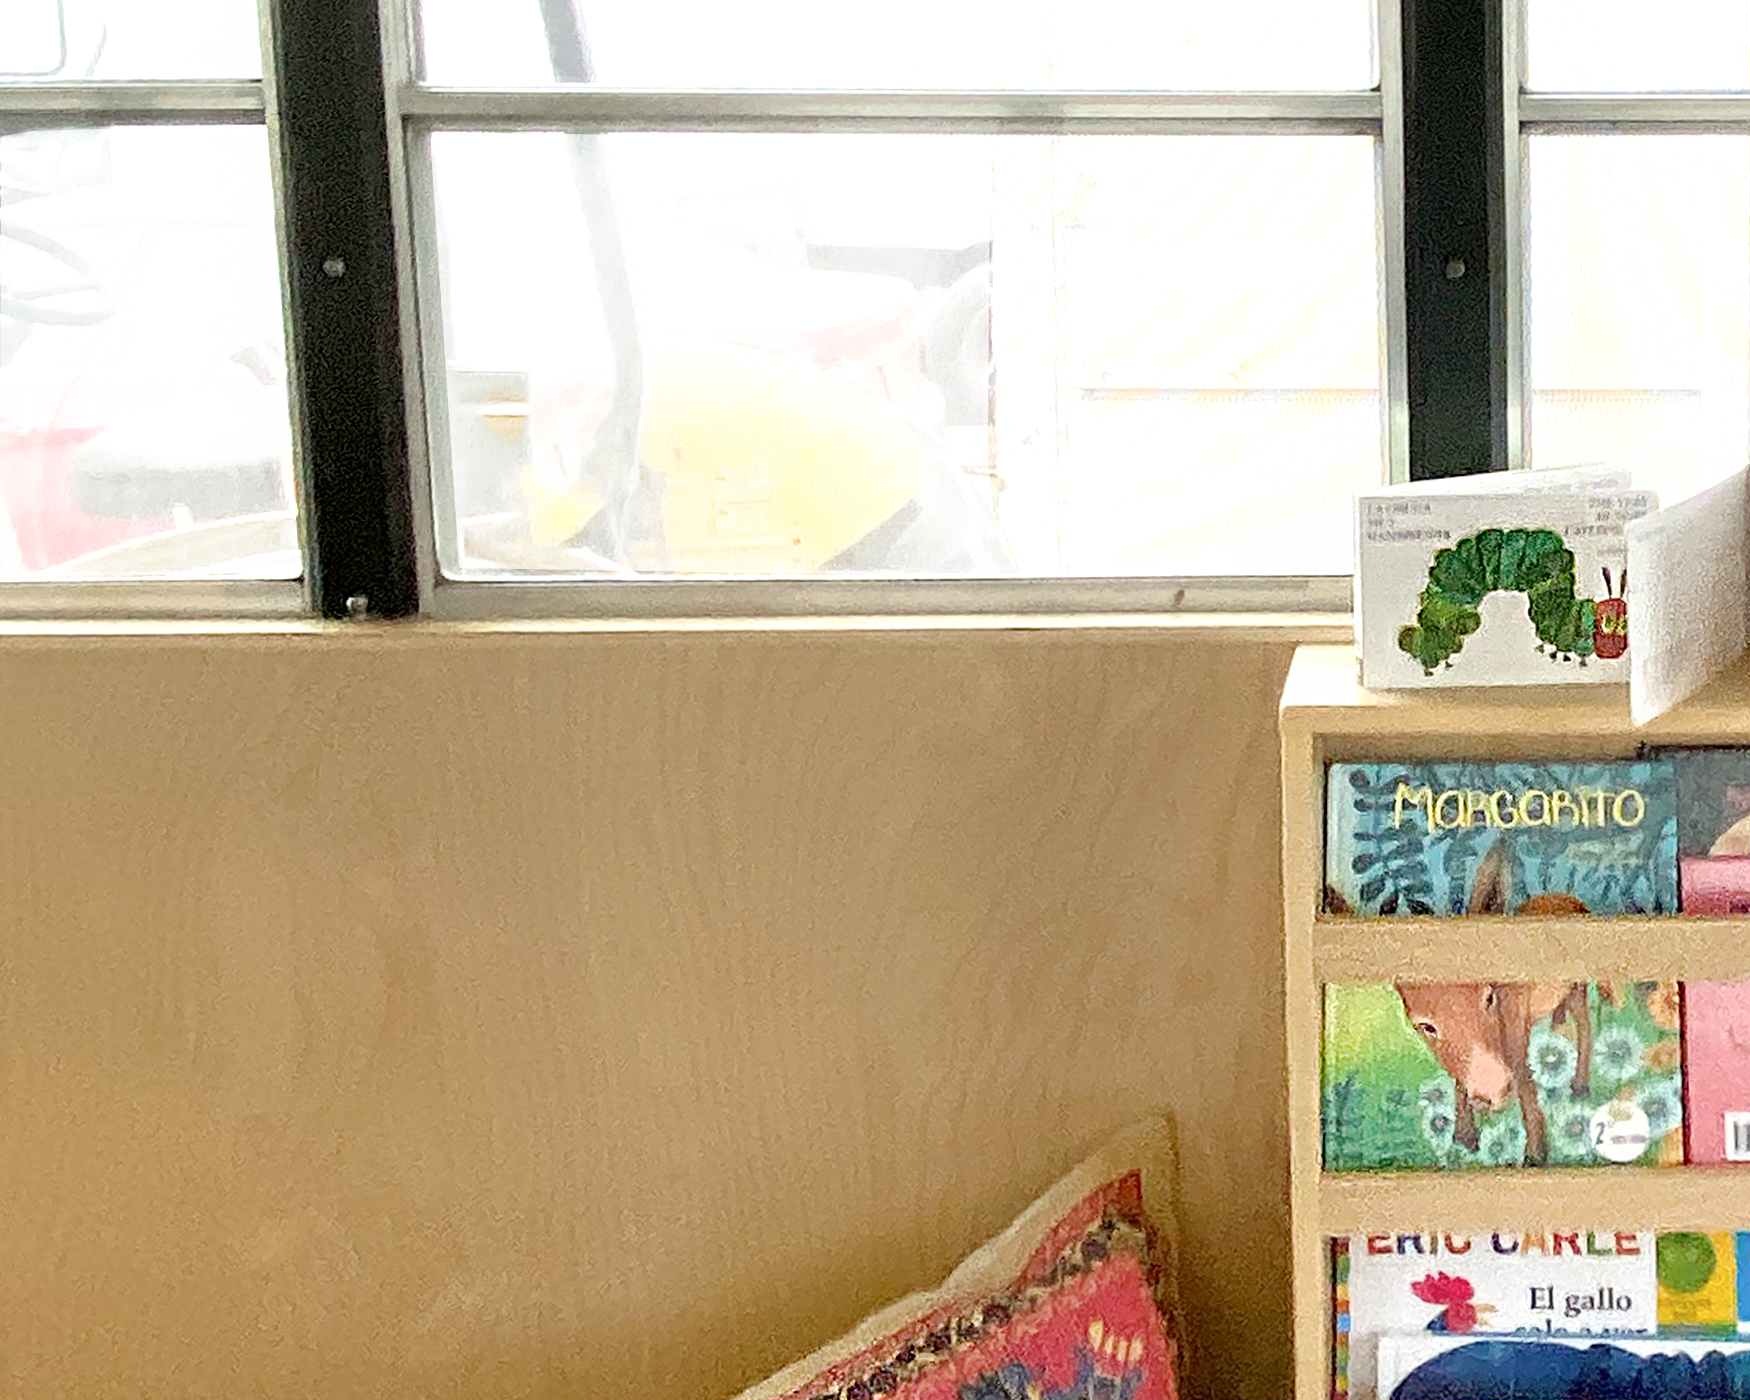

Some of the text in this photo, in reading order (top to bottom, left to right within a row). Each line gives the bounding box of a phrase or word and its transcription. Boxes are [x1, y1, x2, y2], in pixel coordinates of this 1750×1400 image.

[1367, 1231, 1641, 1256] ERIC CARLE
[1530, 1285, 1632, 1318] El gallo
